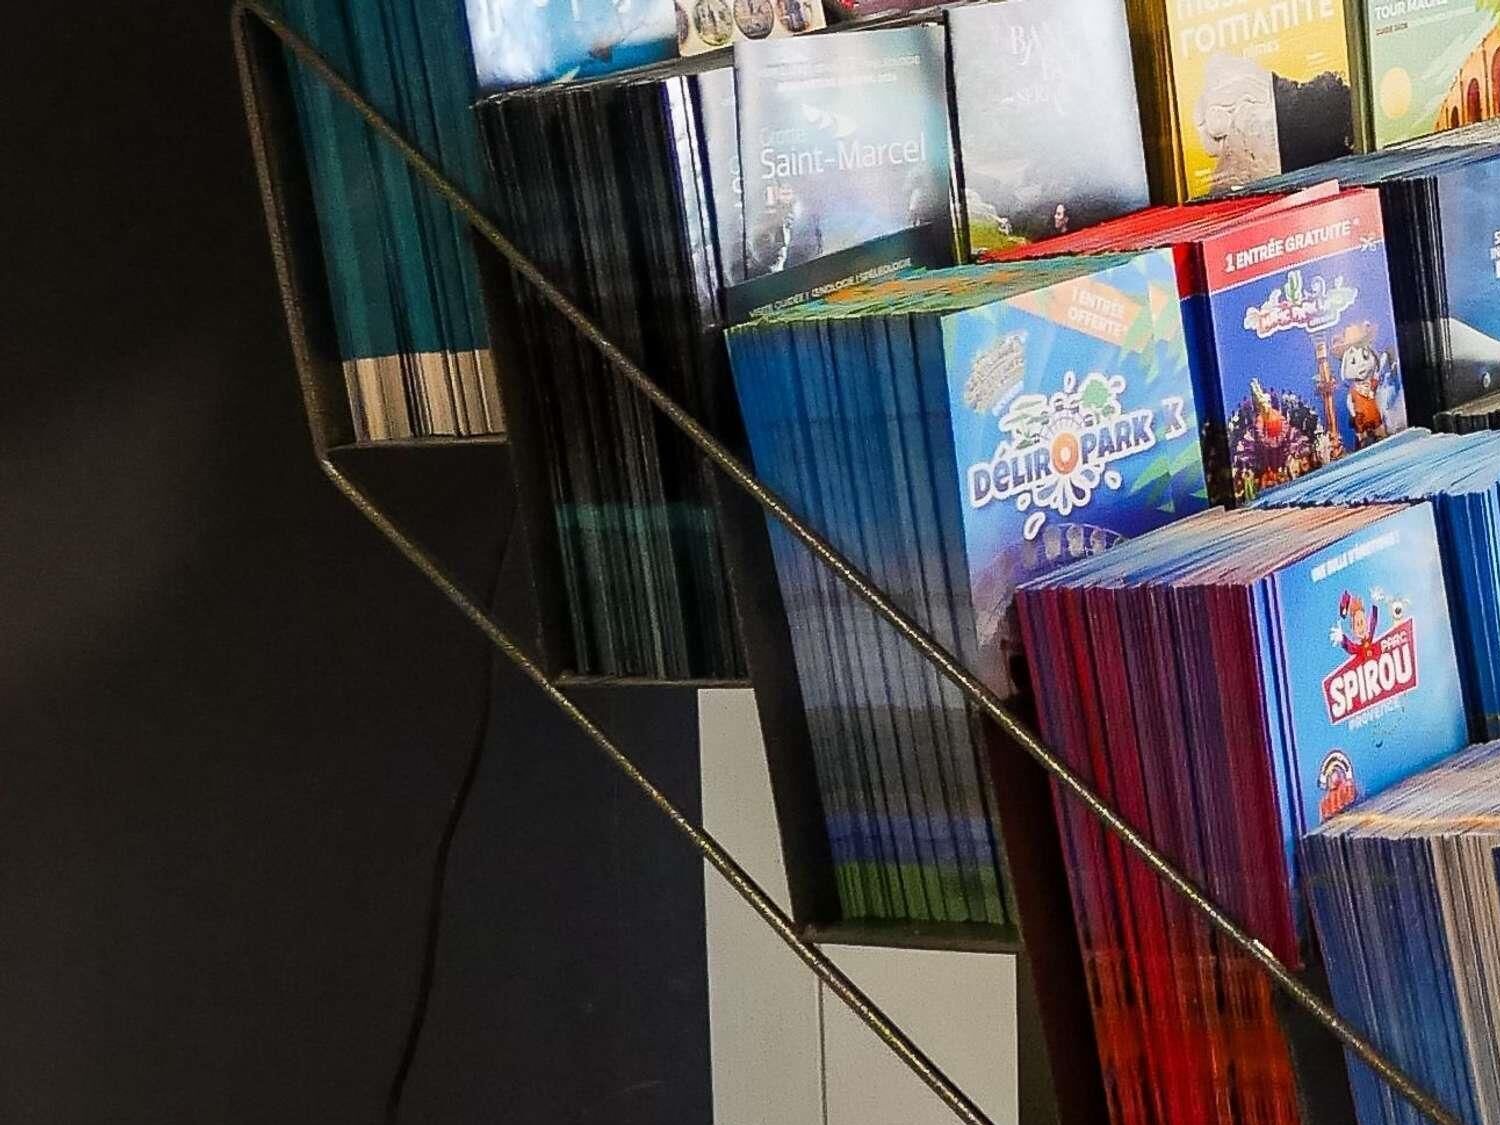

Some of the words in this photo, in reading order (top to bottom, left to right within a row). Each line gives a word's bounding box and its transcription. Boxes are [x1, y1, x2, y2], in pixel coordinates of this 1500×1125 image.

[760, 132, 926, 180] Saint-Marcel
[1236, 237, 1285, 270] ENTRÉE
[1285, 218, 1351, 253] GRATUITE
[1328, 643, 1413, 719] SPIROU
